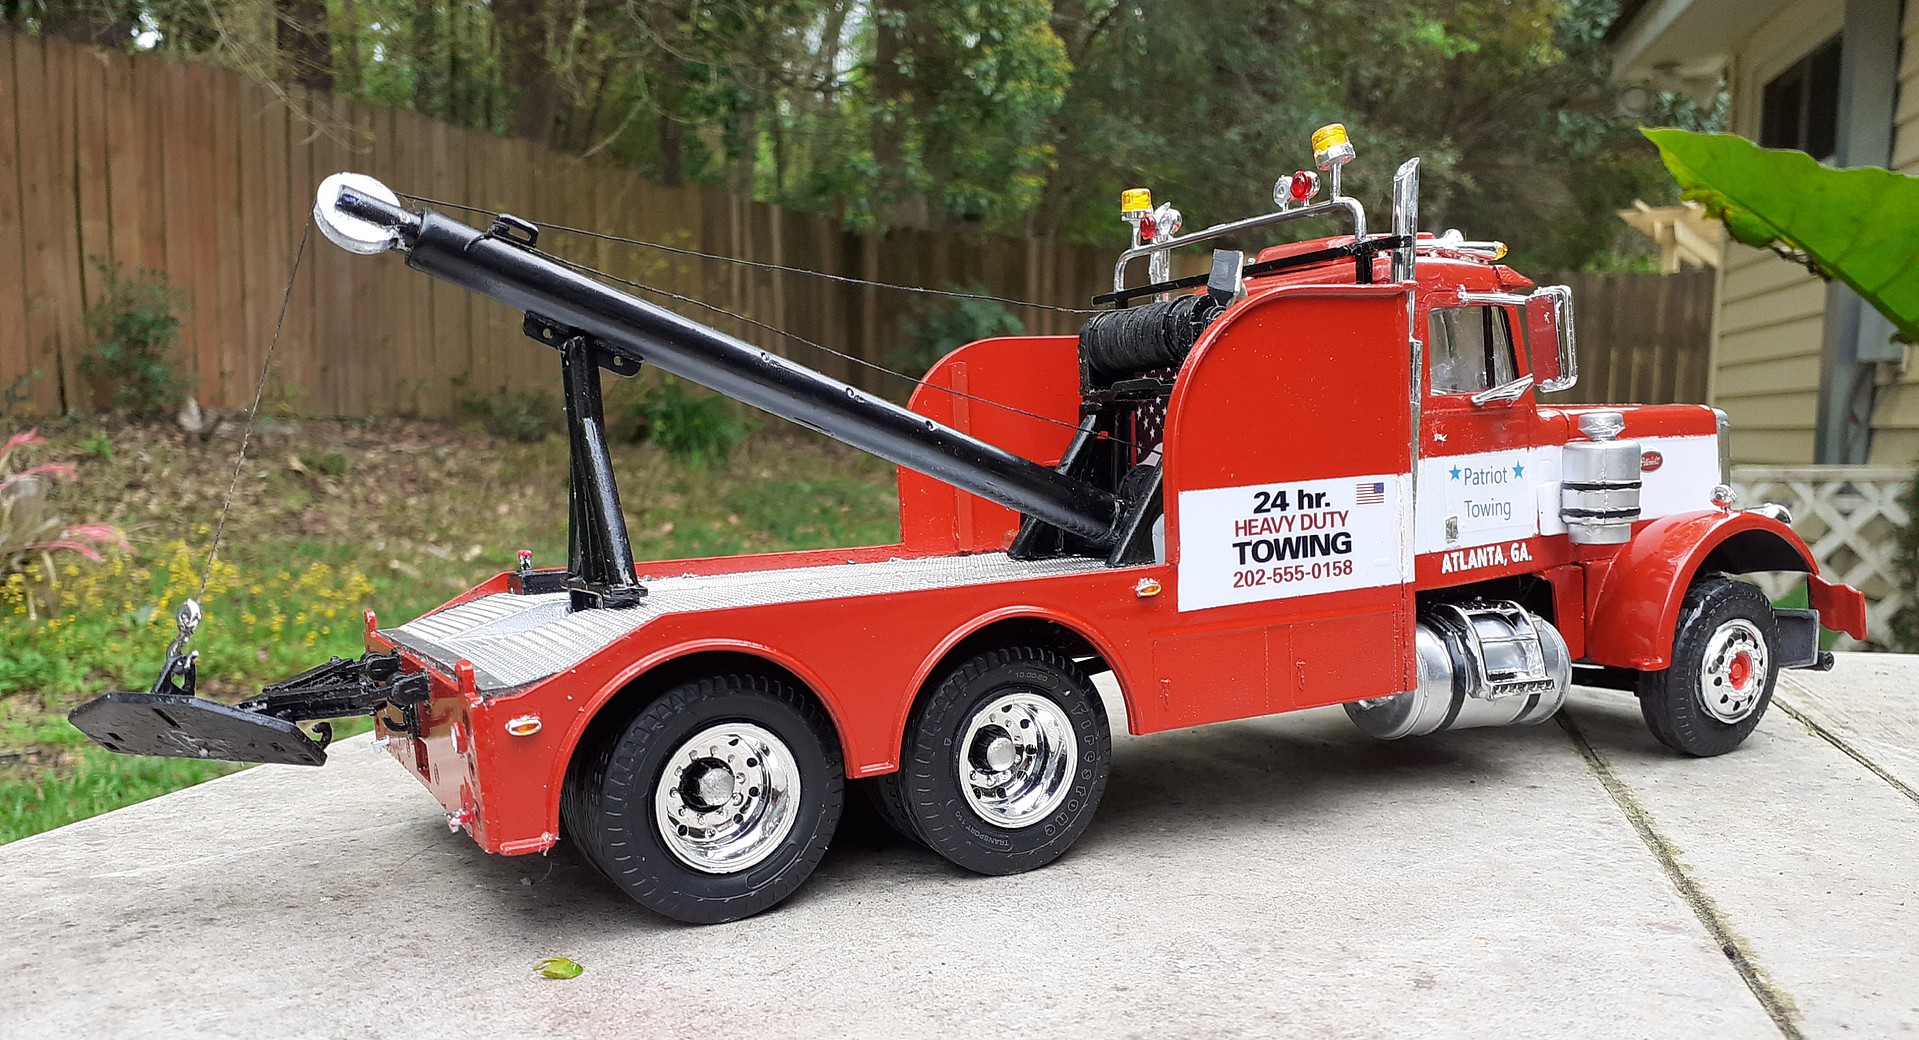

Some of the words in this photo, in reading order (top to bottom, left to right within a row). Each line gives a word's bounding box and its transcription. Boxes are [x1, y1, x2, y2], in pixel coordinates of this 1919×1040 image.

[1464, 465, 1508, 486] Patriot
[1253, 490, 1289, 514] 24
[1298, 489, 1331, 510] hr.
[1464, 499, 1511, 520] Towing
[1235, 514, 1296, 537] HEAVY
[1300, 510, 1349, 529] DUTY
[1232, 531, 1352, 565] TOWING
[1441, 544, 1508, 574] ATLANTA,
[1510, 542, 1533, 563] GA.
[1233, 560, 1353, 588] 202-555-0158
[965, 824, 1009, 846] TRANSPORT
